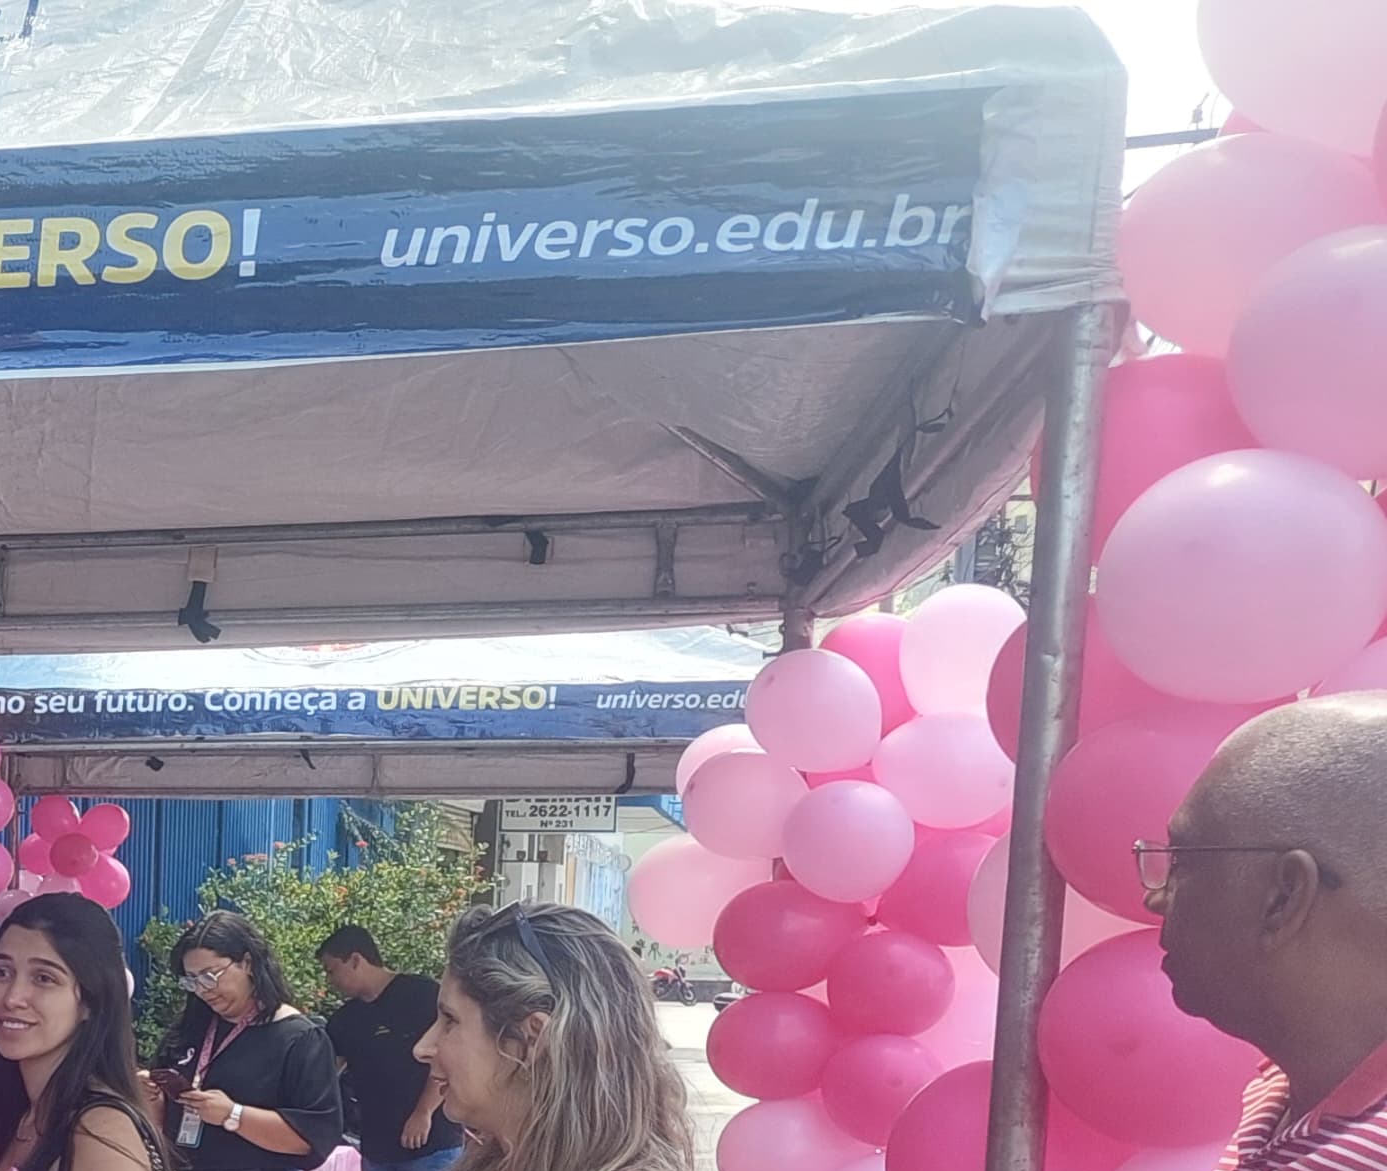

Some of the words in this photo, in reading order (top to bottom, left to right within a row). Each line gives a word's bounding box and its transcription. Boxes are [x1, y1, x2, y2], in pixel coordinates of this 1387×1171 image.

[380, 194, 971, 269] universo.edu.br
[33, 694, 84, 713] seu
[95, 691, 195, 712] futuro.
[204, 688, 337, 715] Conheça
[347, 692, 366, 711] a
[377, 685, 557, 711] UNIVERSO!
[529, 805, 611, 817] 2622-1117
[555, 820, 573, 828] 231
